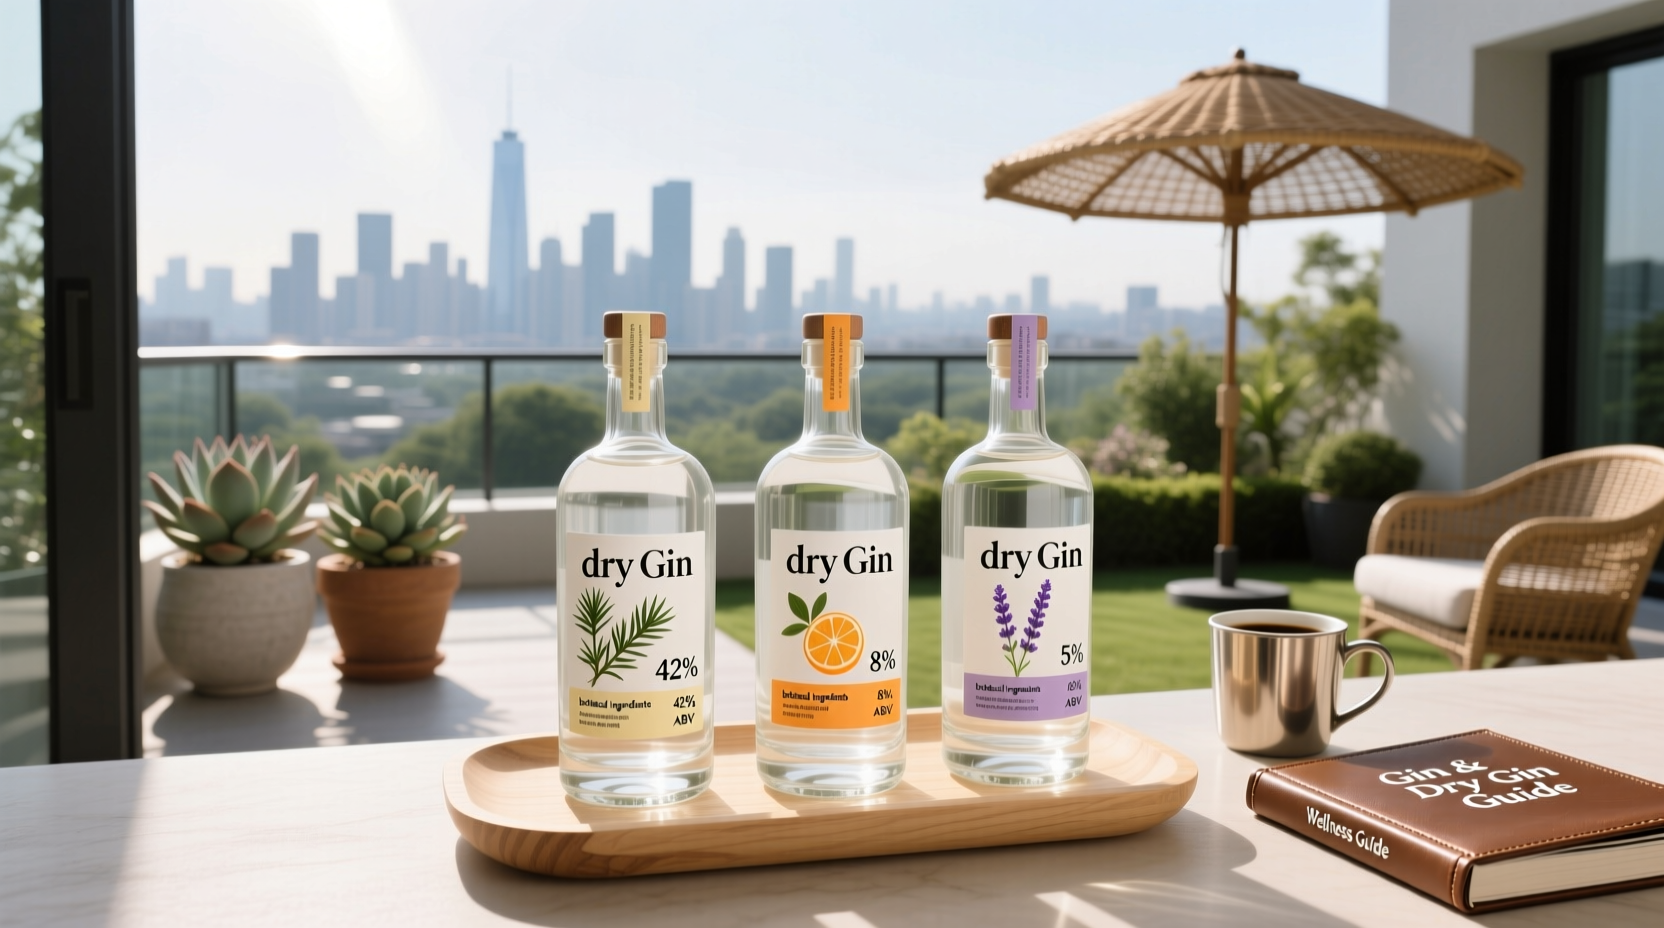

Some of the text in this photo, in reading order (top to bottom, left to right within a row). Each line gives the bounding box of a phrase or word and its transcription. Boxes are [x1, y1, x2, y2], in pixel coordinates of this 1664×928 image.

[581, 547, 693, 588] dry Gin
[786, 544, 894, 584] dry Gin
[980, 540, 1083, 579] dry Gin
[870, 649, 896, 672] 8%
[1060, 642, 1084, 665] 5%
[655, 656, 698, 681] 42%
[673, 713, 695, 726] ABV
[1379, 759, 1489, 785] Gin &
[1404, 766, 1560, 799] Dry Gin
[1462, 781, 1578, 808] Guide
[1306, 806, 1353, 842] Wellness
